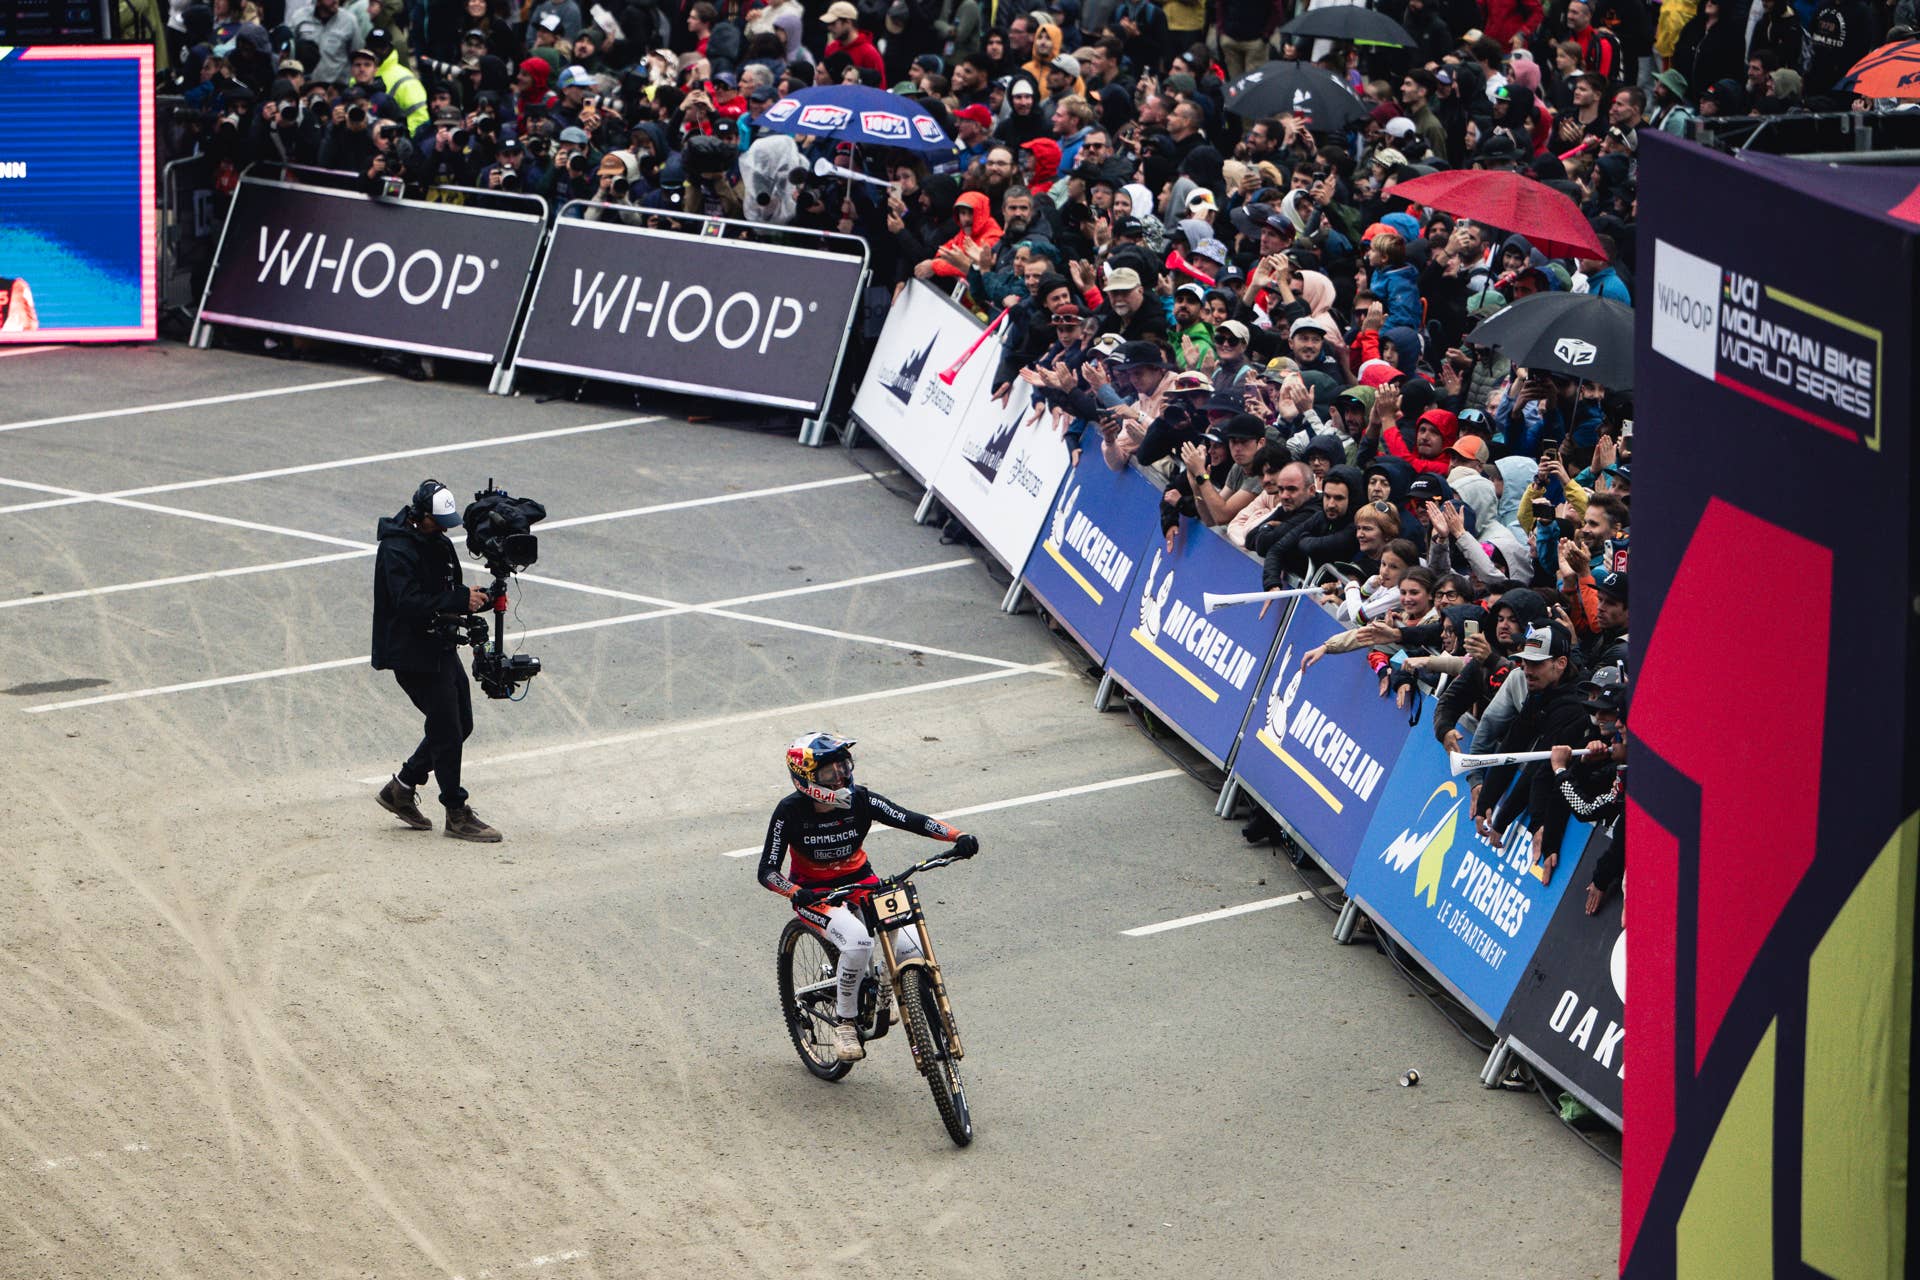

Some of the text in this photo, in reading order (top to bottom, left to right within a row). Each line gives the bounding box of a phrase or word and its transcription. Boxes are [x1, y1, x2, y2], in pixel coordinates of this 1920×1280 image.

[804, 108, 846, 126] 100%
[866, 115, 904, 134] 100%
[258, 226, 484, 309] WHOOP
[1658, 282, 1712, 332] WHOOP
[1730, 272, 1759, 310] UCI
[571, 268, 803, 354] WHOOP
[1722, 304, 1871, 388] MOUNTAIN BIKE
[1720, 333, 1871, 418] WORLD SERIES
[1065, 510, 1133, 592] MICHELIN
[1162, 599, 1257, 690] MICHELIN
[1288, 700, 1385, 802] MICHELIN
[804, 829, 859, 845] COMMENCAL
[1475, 818, 1534, 876] UTES
[885, 898, 898, 913] 9
[1437, 899, 1507, 970] LE DÉPARTEMENT
[1452, 850, 1531, 938] PYRÉNÉES
[1549, 990, 1624, 1080] OAK
